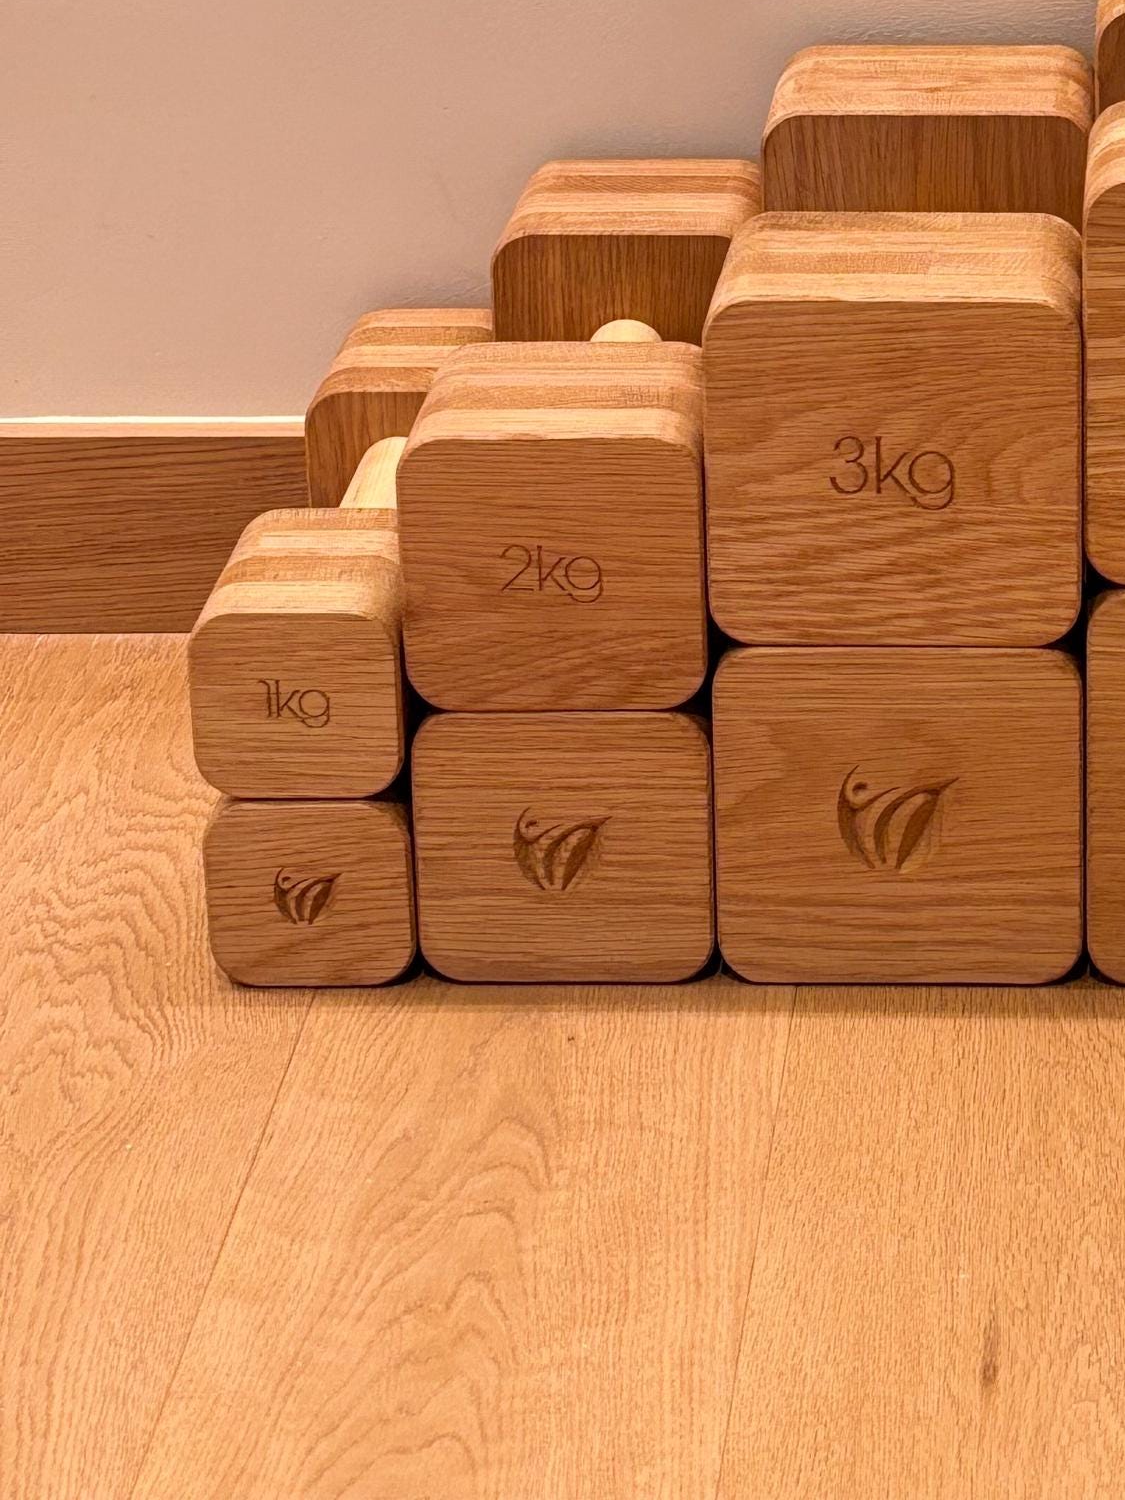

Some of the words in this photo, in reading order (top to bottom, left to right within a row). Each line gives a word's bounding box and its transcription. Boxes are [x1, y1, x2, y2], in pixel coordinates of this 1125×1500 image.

[828, 435, 956, 511] 3kg
[499, 544, 604, 604] 2kg
[257, 679, 331, 728] 1kg
